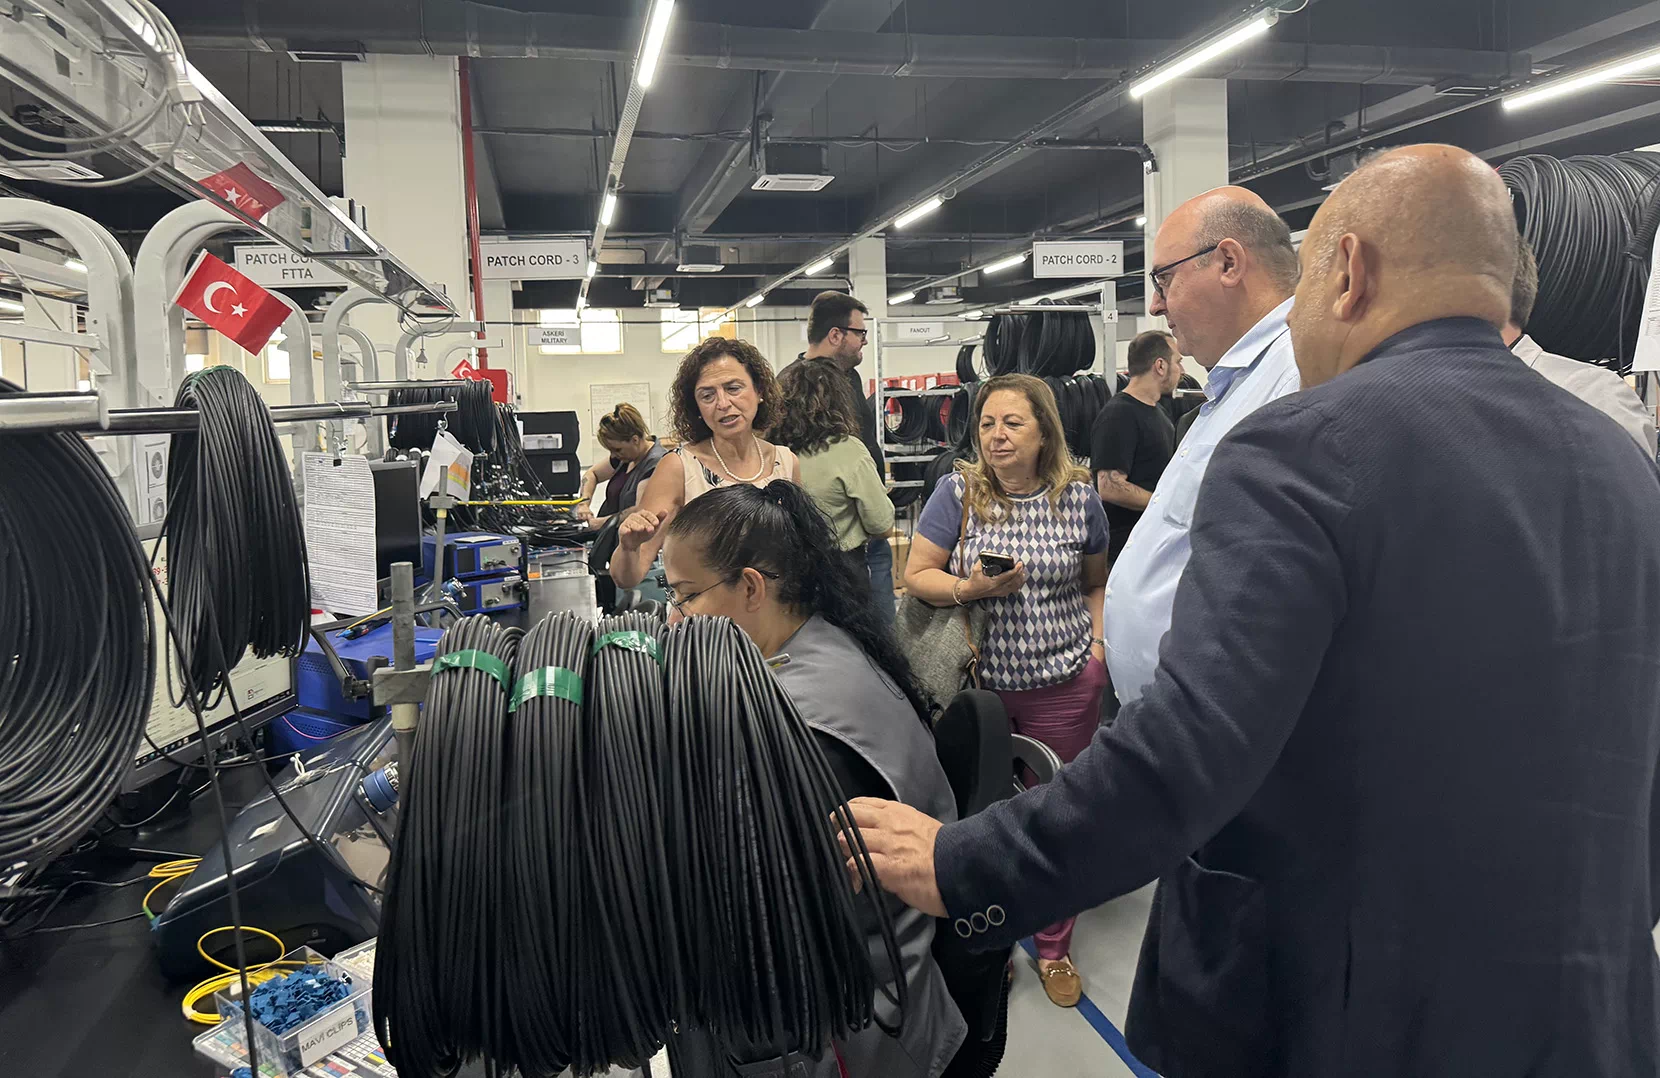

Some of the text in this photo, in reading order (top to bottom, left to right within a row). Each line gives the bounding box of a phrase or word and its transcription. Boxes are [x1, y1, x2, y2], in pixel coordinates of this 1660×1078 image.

[245, 253, 314, 265] PATCH CO
[487, 255, 526, 267] PATCH
[529, 254, 563, 266] CORD
[572, 254, 580, 265] 3
[1042, 255, 1074, 265] PATCH
[1075, 254, 1104, 265] CORD
[1111, 254, 1117, 264] 2
[281, 268, 314, 279] FTTA
[1107, 312, 1114, 320] 4
[326, 1017, 354, 1038] CLIPS
